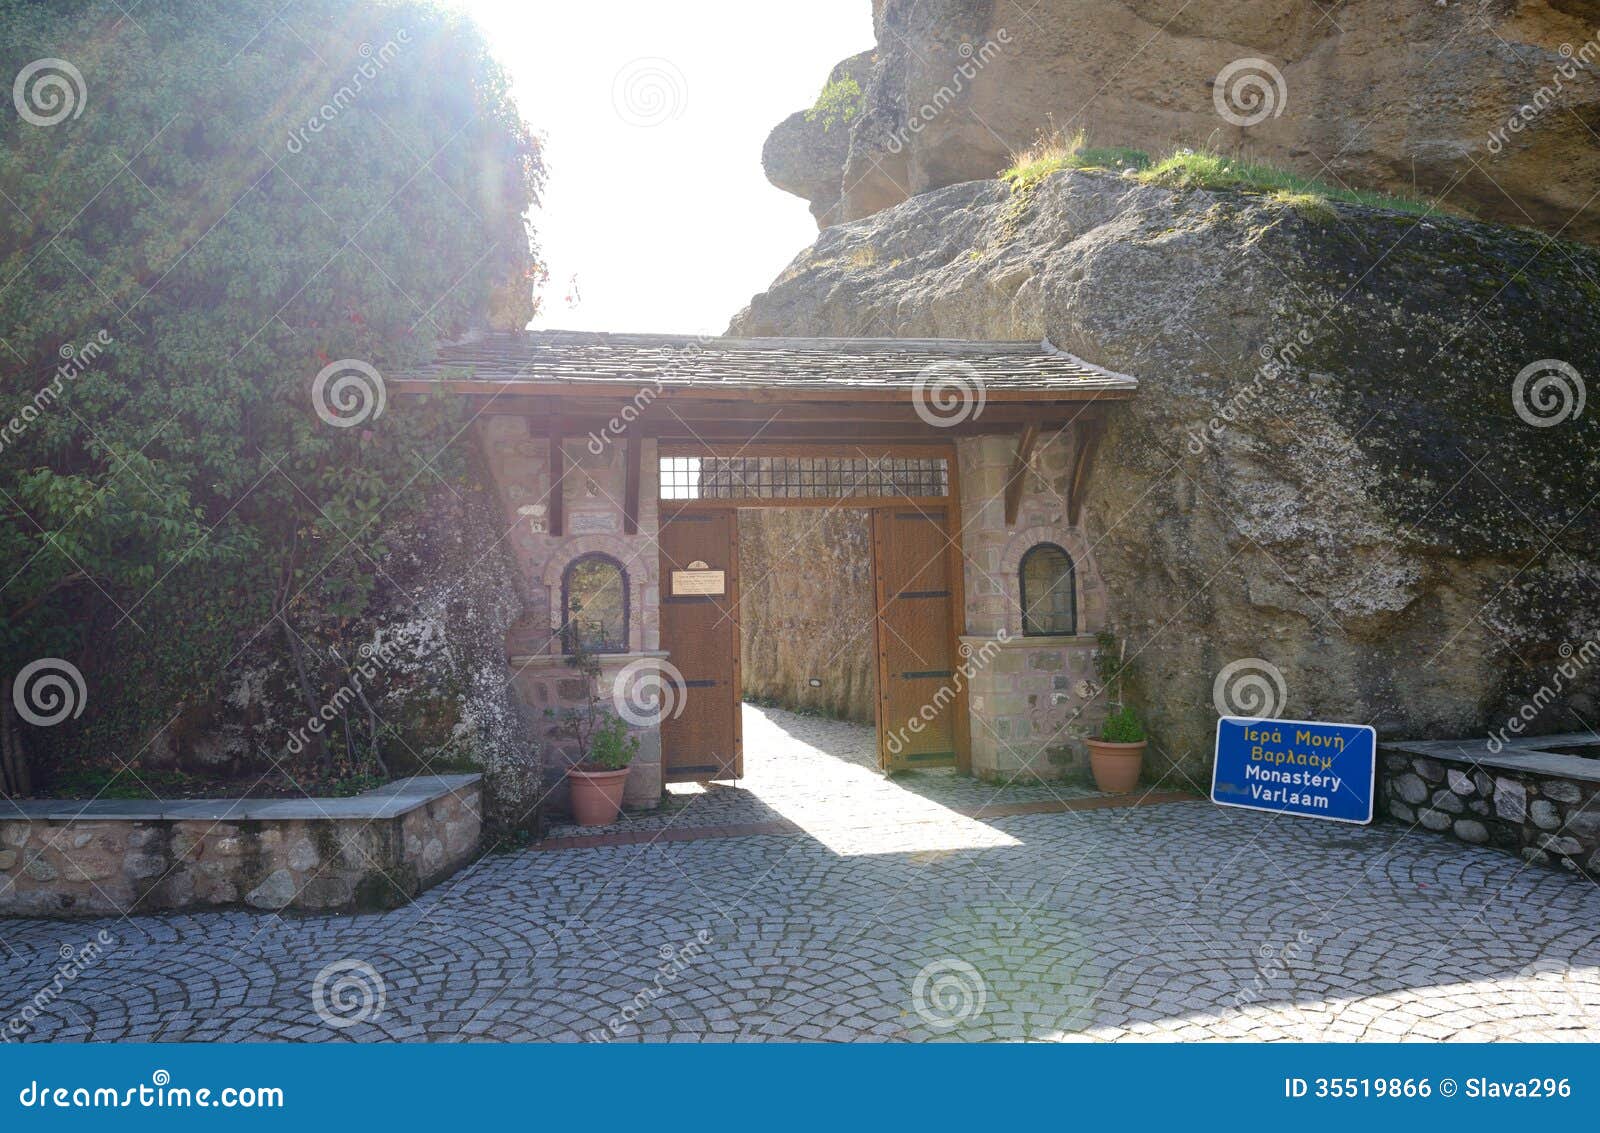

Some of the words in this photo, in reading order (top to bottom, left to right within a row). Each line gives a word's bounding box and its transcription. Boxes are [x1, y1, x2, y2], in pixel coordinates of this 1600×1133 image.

[1244, 727, 1282, 745] Ιερά
[1296, 730, 1345, 752] Μονή
[1251, 746, 1333, 771] Βαρλαάμ
[1245, 764, 1341, 793] Monastery
[1251, 783, 1329, 809] Varlaam
